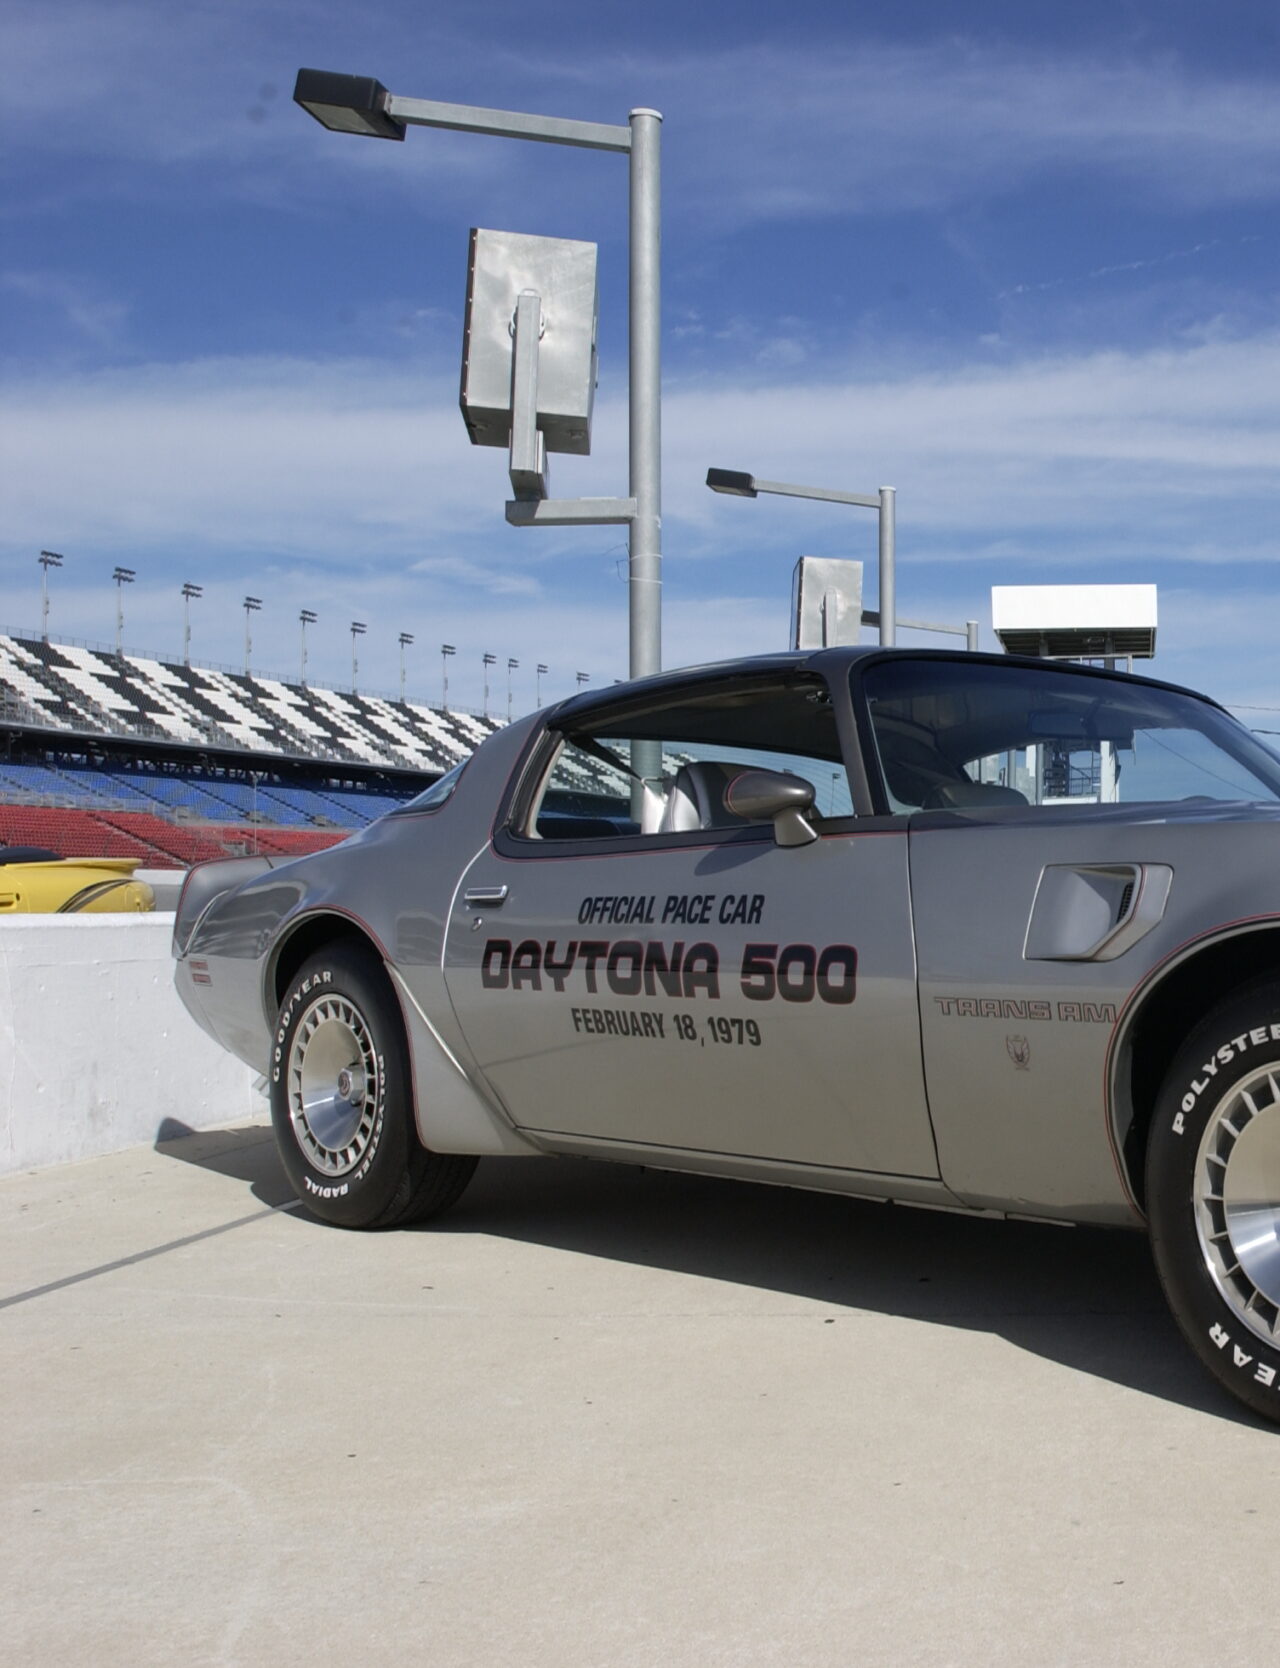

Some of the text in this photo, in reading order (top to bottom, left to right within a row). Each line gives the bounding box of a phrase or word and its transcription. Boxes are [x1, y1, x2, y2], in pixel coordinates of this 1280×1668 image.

[576, 894, 765, 925] OFFICIAL PACE CAR
[480, 938, 858, 1005] DAYTONA 500
[273, 970, 332, 1083] GOODYEAR
[571, 1007, 665, 1039] FEBRUARY
[934, 996, 1118, 1023] TRANS AM
[304, 1055, 386, 1199] POLYSTEEL RADIAL
